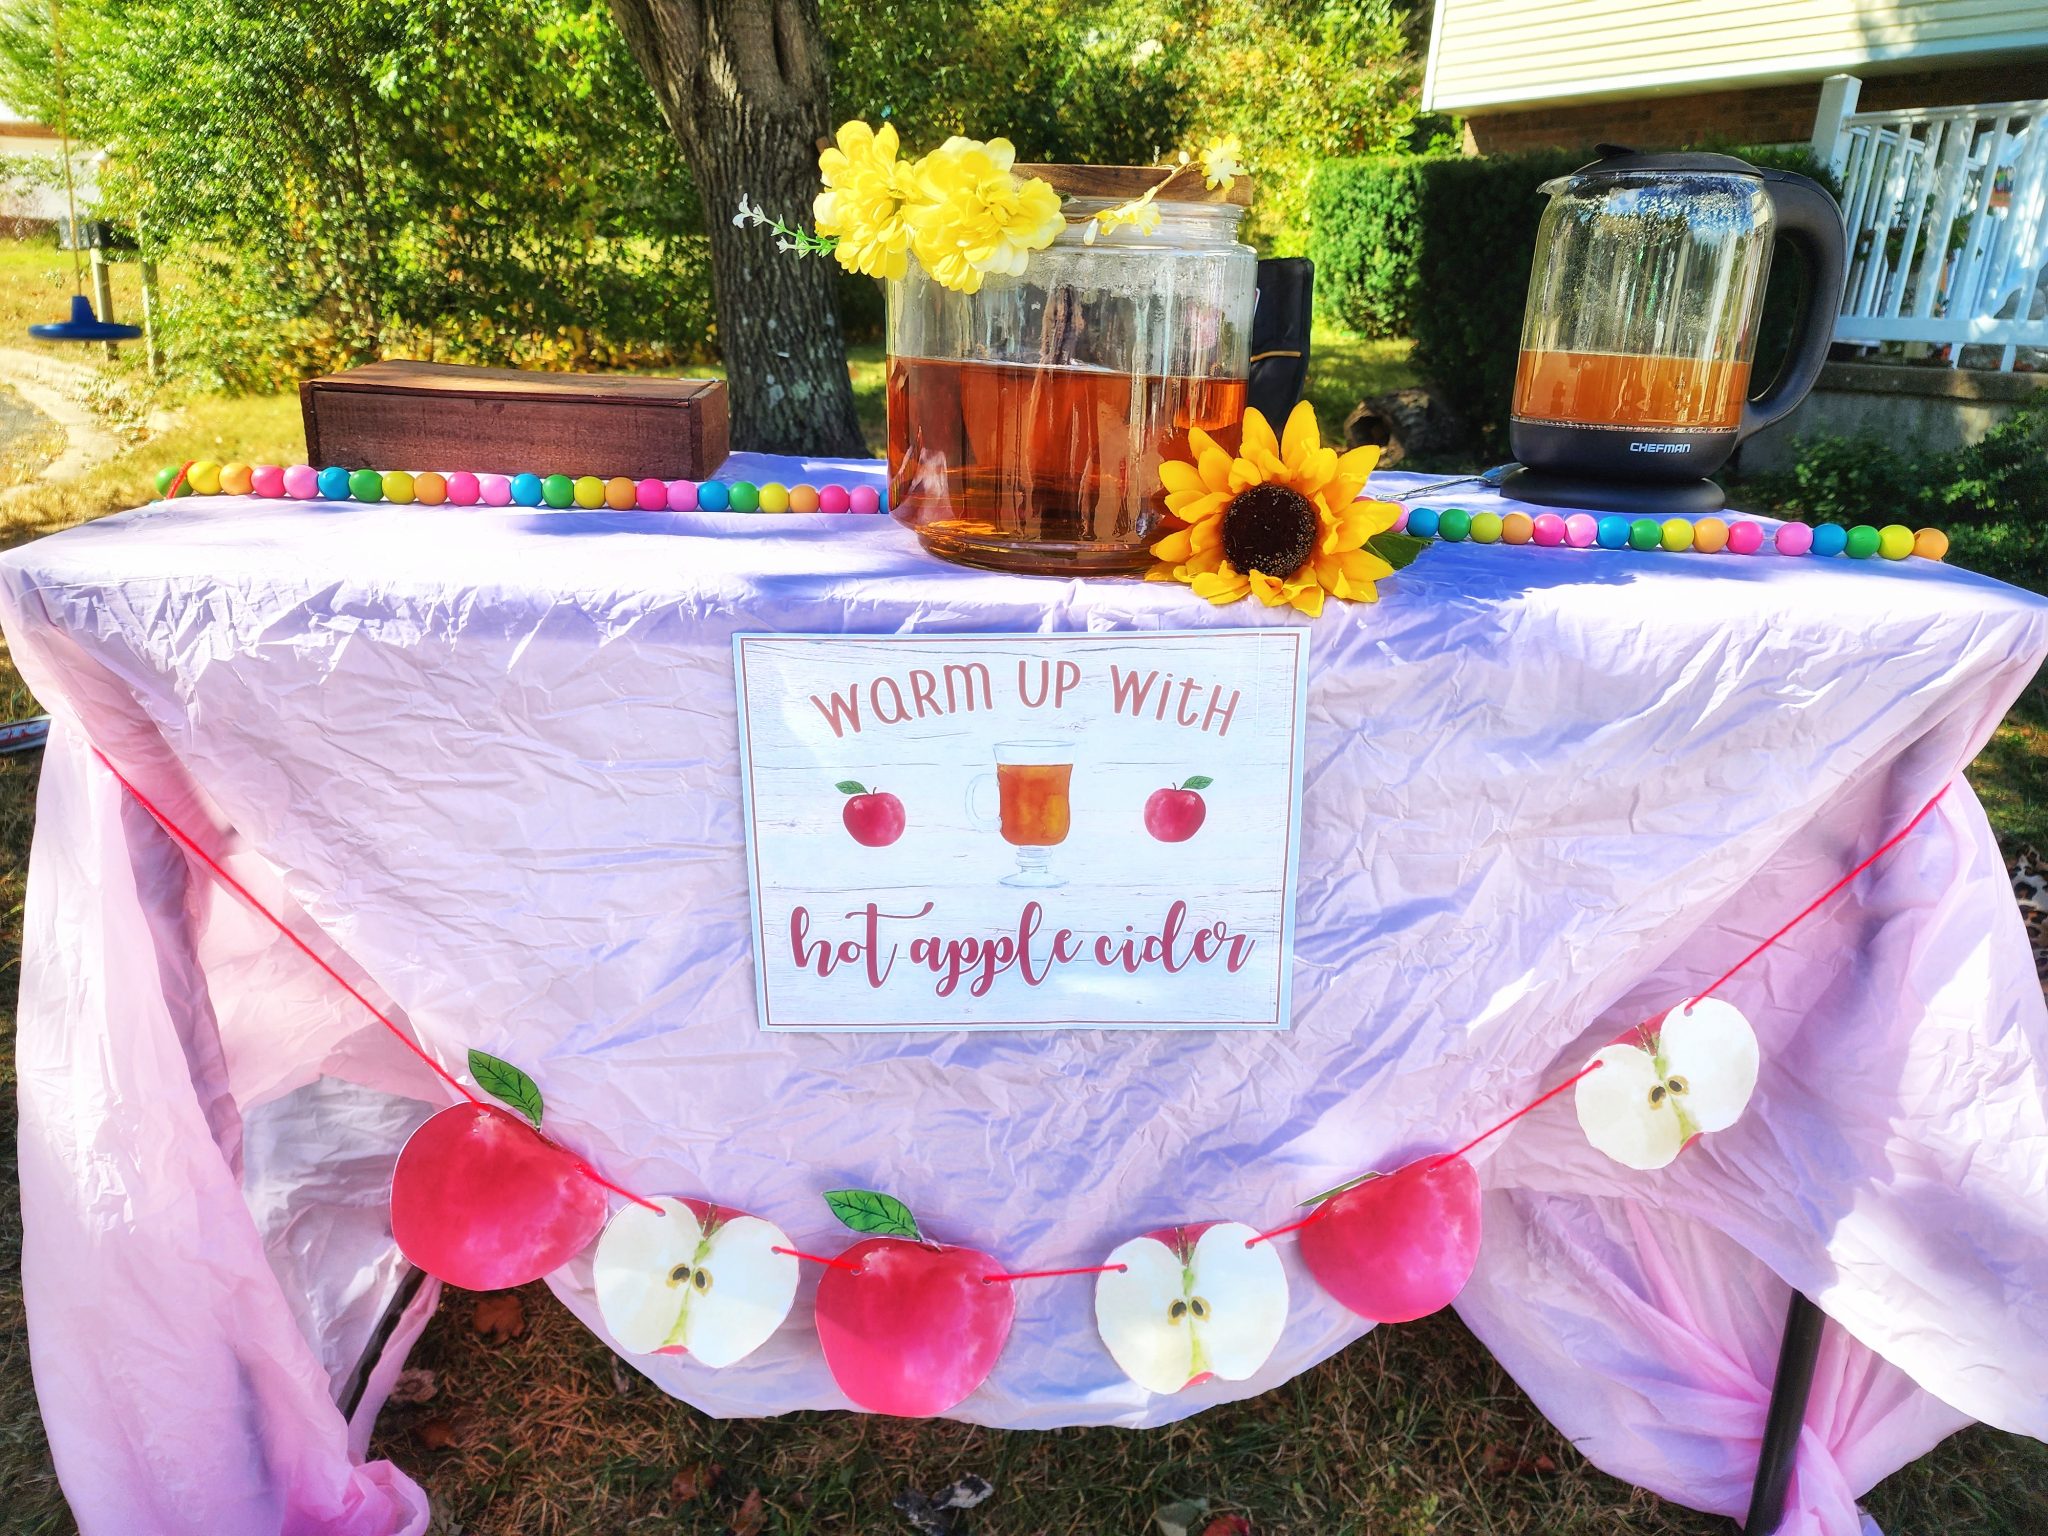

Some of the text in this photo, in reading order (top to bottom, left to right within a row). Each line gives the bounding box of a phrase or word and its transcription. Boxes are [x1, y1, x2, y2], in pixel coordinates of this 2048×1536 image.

[1629, 442, 1691, 453] CHEFMAN
[1018, 660, 1082, 709] UP
[790, 900, 1256, 998] hot apple cider
